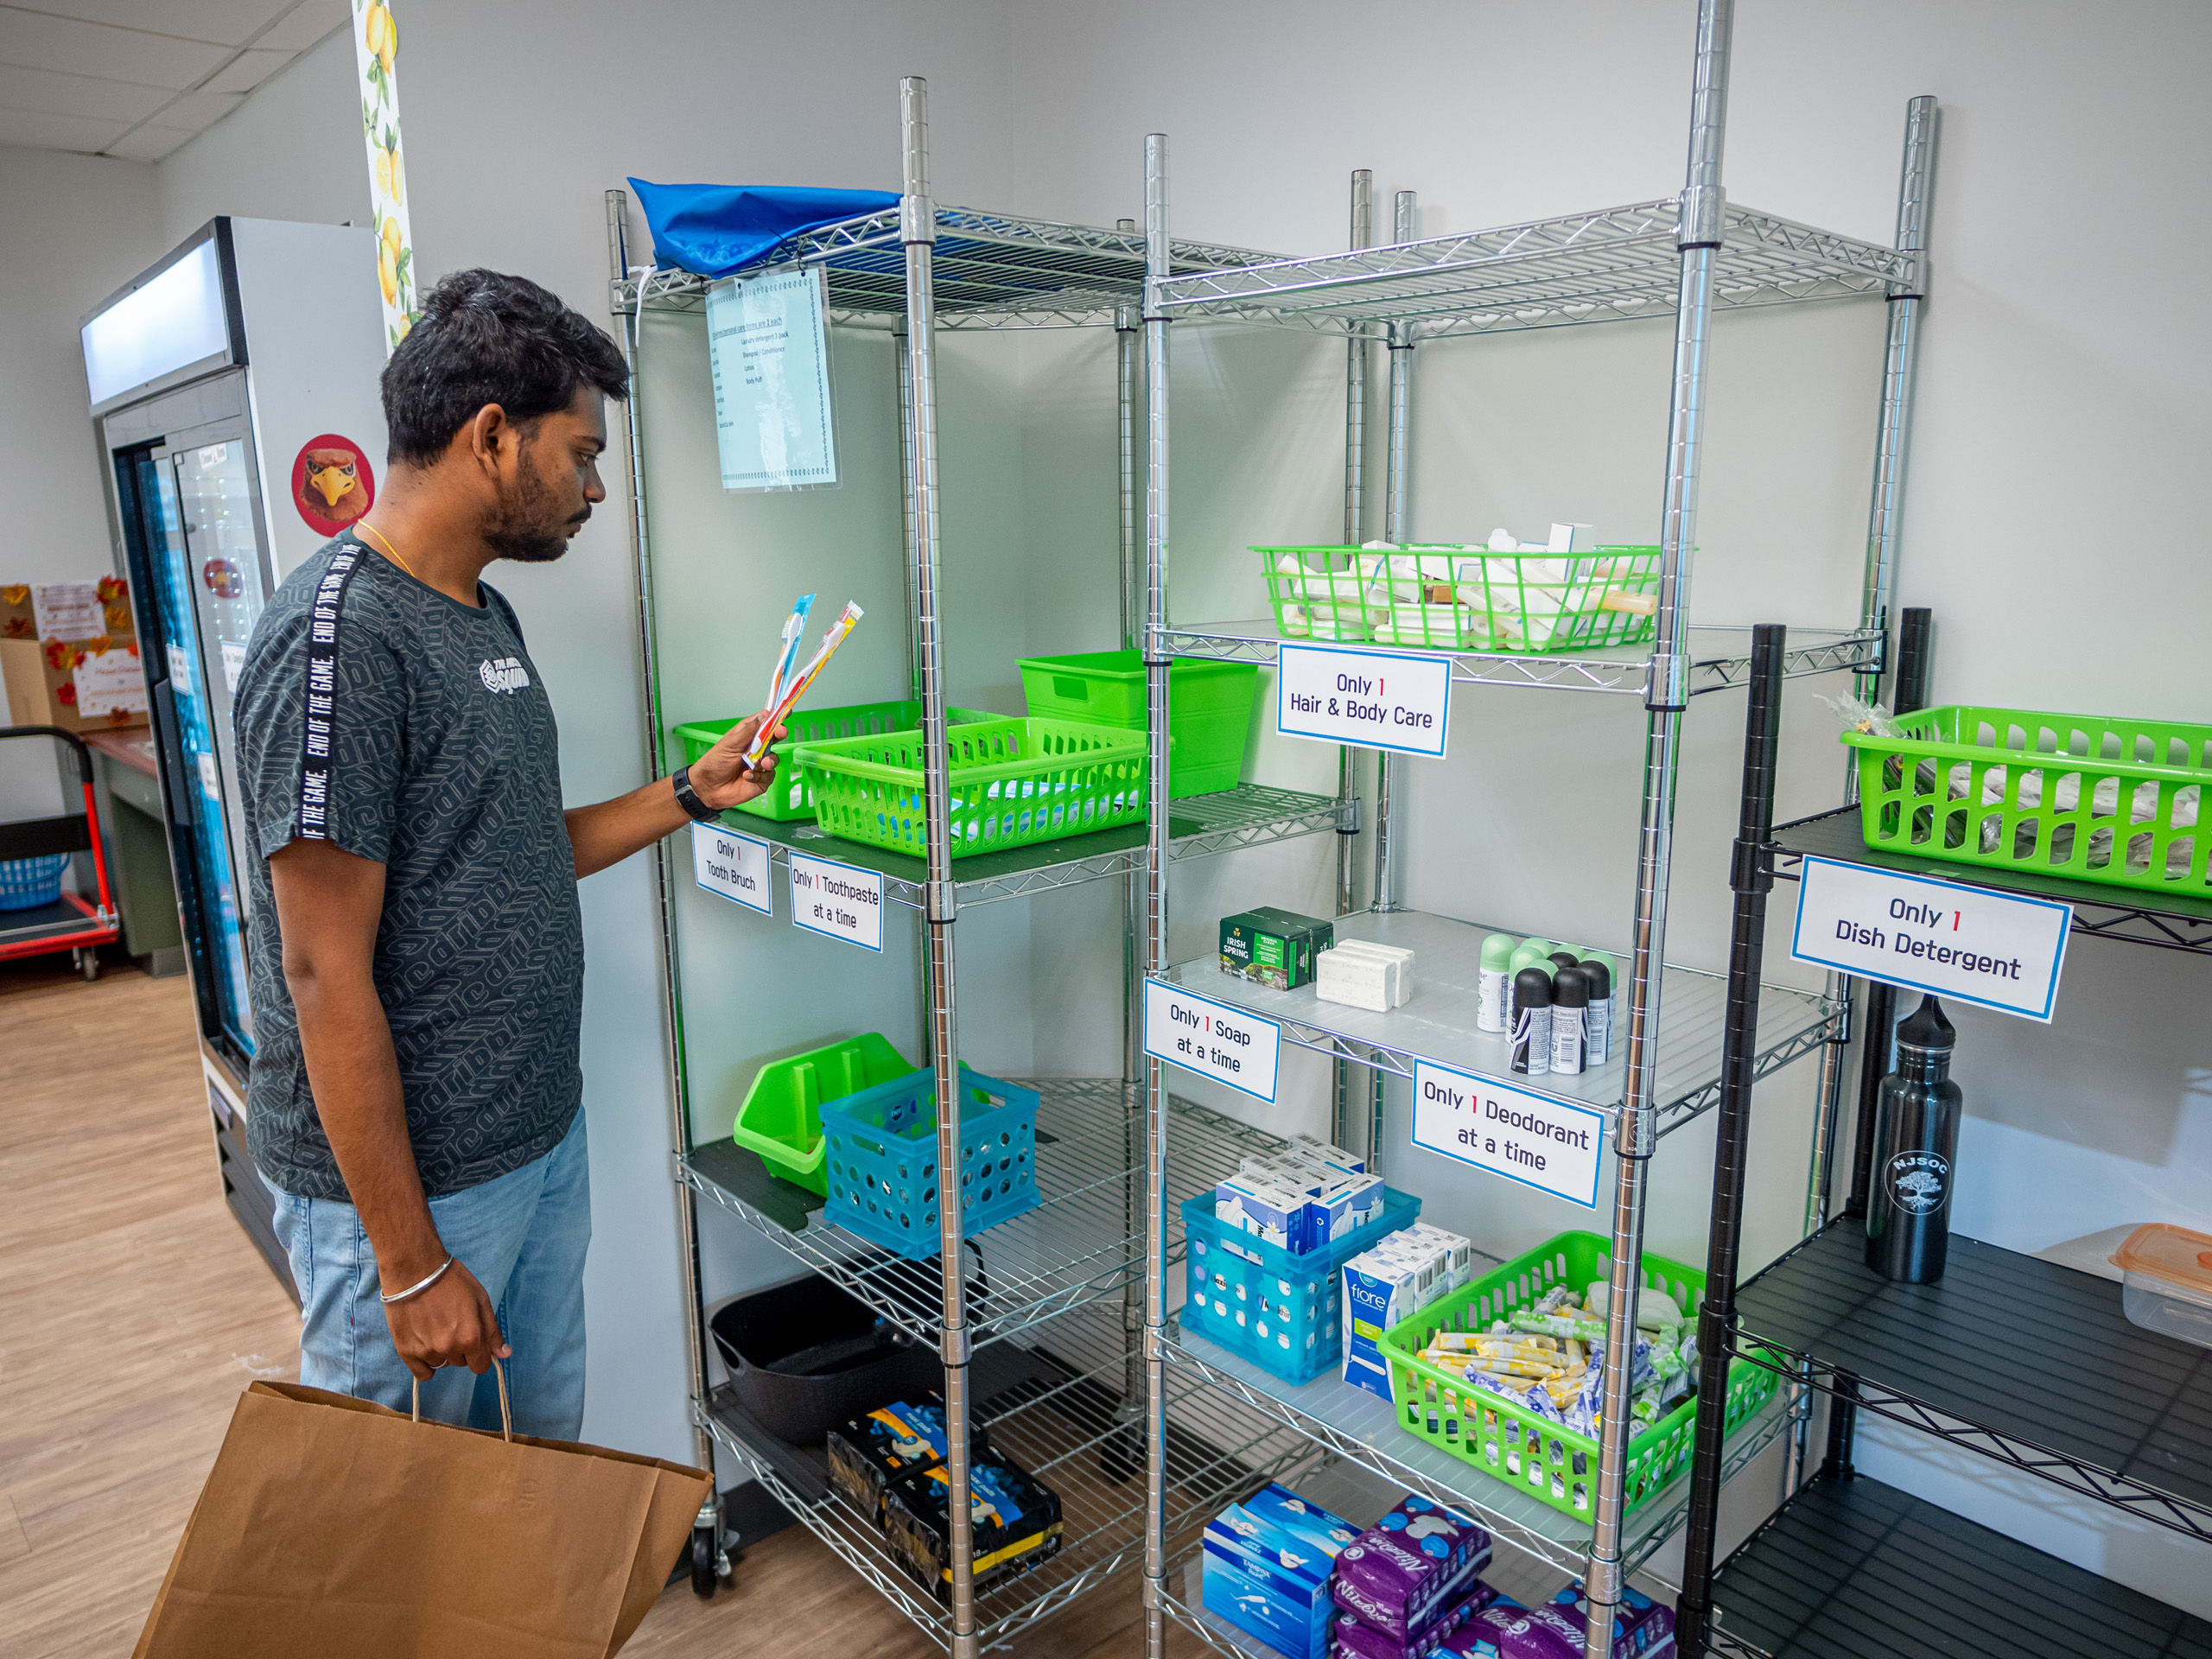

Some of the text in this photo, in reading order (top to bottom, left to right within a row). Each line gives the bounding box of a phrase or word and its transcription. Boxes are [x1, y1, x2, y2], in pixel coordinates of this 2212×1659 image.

[771, 316, 783, 326] each
[316, 590, 340, 605] THE
[314, 607, 336, 620] OF
[312, 621, 335, 643] END
[1337, 673, 1384, 696] Only 1
[307, 656, 334, 757] END OF THE GAME.
[1291, 693, 1433, 728] Hair & Body Care
[303, 769, 327, 803] GAME.
[302, 804, 325, 824] THE
[716, 839, 741, 861] Only 1
[706, 860, 756, 892] Tooth Bruch
[793, 868, 879, 906] Only 1 Toothpaste
[814, 903, 856, 929] at a time
[1889, 898, 1961, 931] Only 1
[1224, 944, 1249, 959] SPRING
[1227, 937, 1246, 949] IRISH
[1835, 918, 2021, 980] Dish Detergent
[1170, 1004, 1250, 1046] Only 1 Soap
[1177, 1038, 1241, 1072] at a time
[1424, 1081, 1589, 1150] Only 1 Deodorant
[1458, 1128, 1546, 1171] at a time
[1893, 1156, 1948, 1174] NJSOC
[1351, 1283, 1386, 1308] fiore
[1243, 1558, 1272, 1578] TAMPAX
